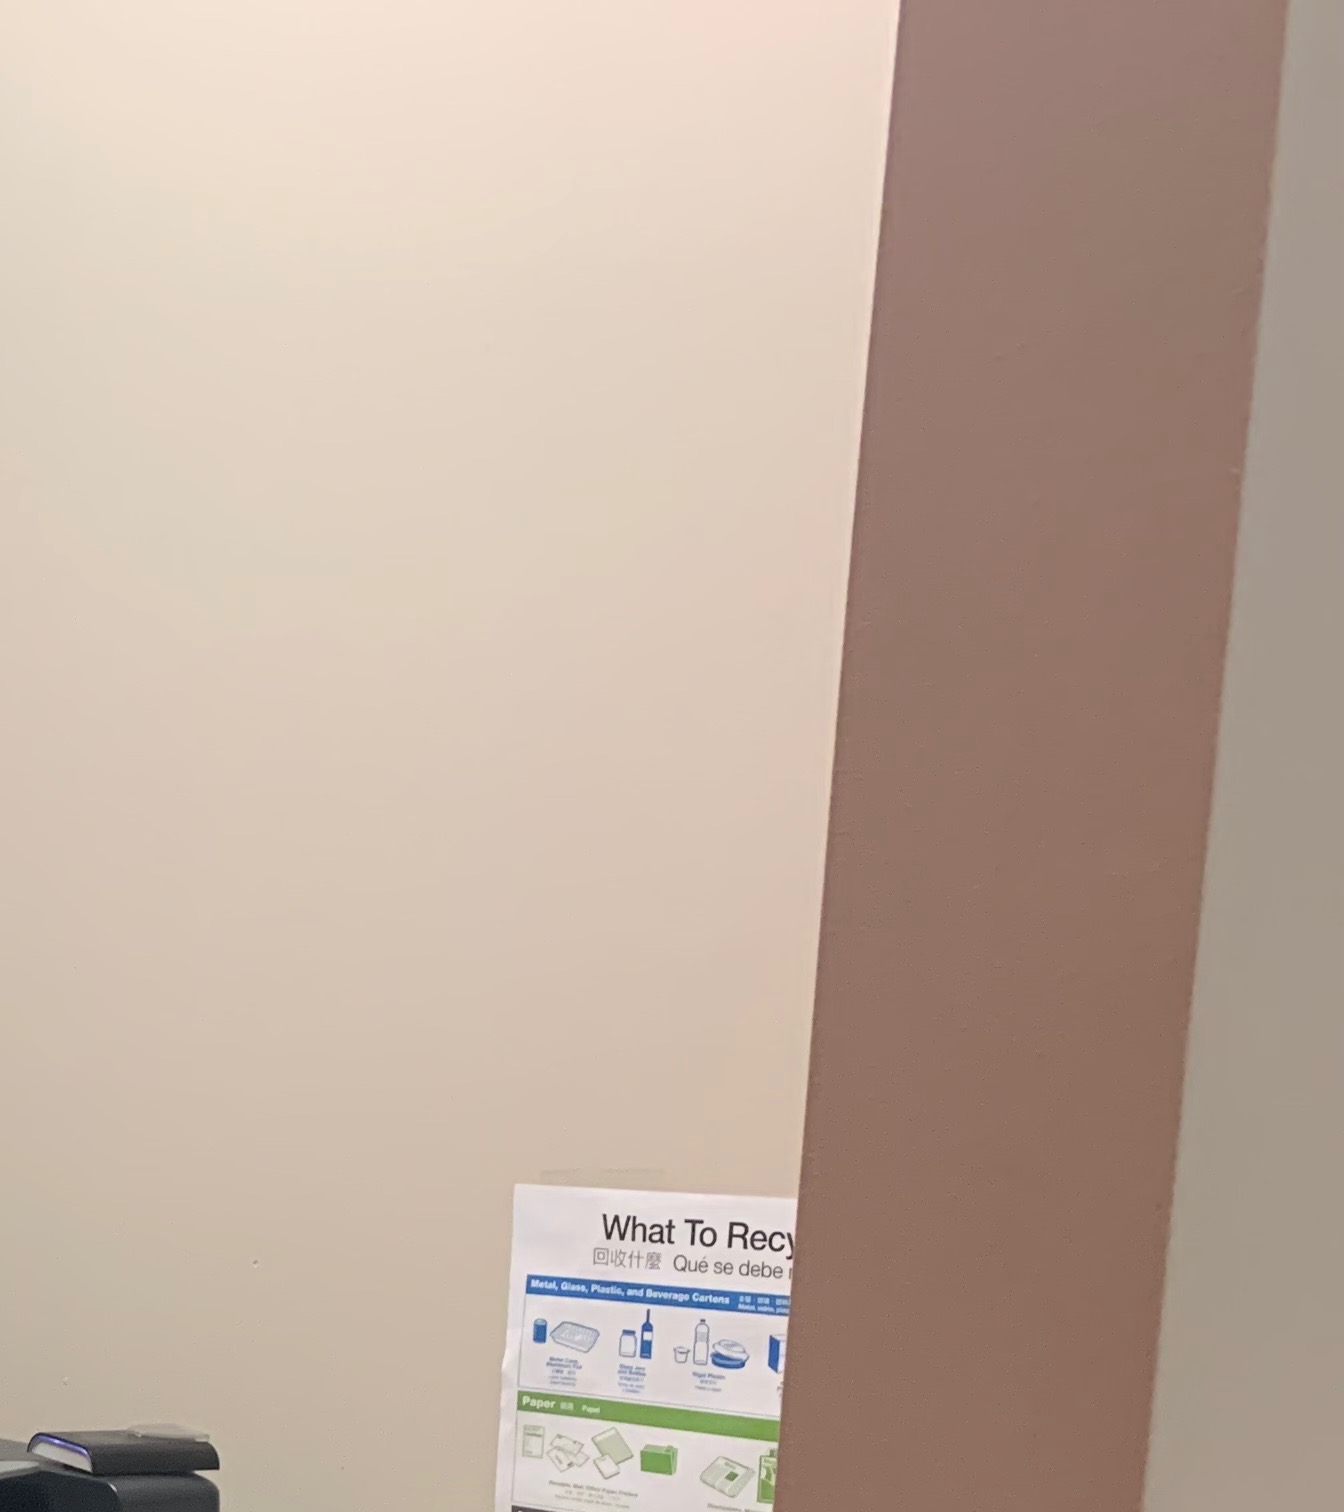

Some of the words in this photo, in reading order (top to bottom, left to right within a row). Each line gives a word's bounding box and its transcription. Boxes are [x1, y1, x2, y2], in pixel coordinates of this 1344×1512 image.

[602, 1213, 676, 1245] What
[684, 1218, 718, 1248] To
[592, 1247, 662, 1270] 回收什麼
[673, 1254, 709, 1274] Qué
[713, 1260, 734, 1276] se
[738, 1260, 784, 1280] debe
[530, 1279, 558, 1292] Metal,
[560, 1281, 589, 1294] Glass,
[591, 1284, 625, 1297] Plastic,
[626, 1286, 644, 1298] and
[646, 1288, 690, 1302] Beverage
[692, 1292, 730, 1304] Cartons
[522, 1395, 556, 1410] Paper
